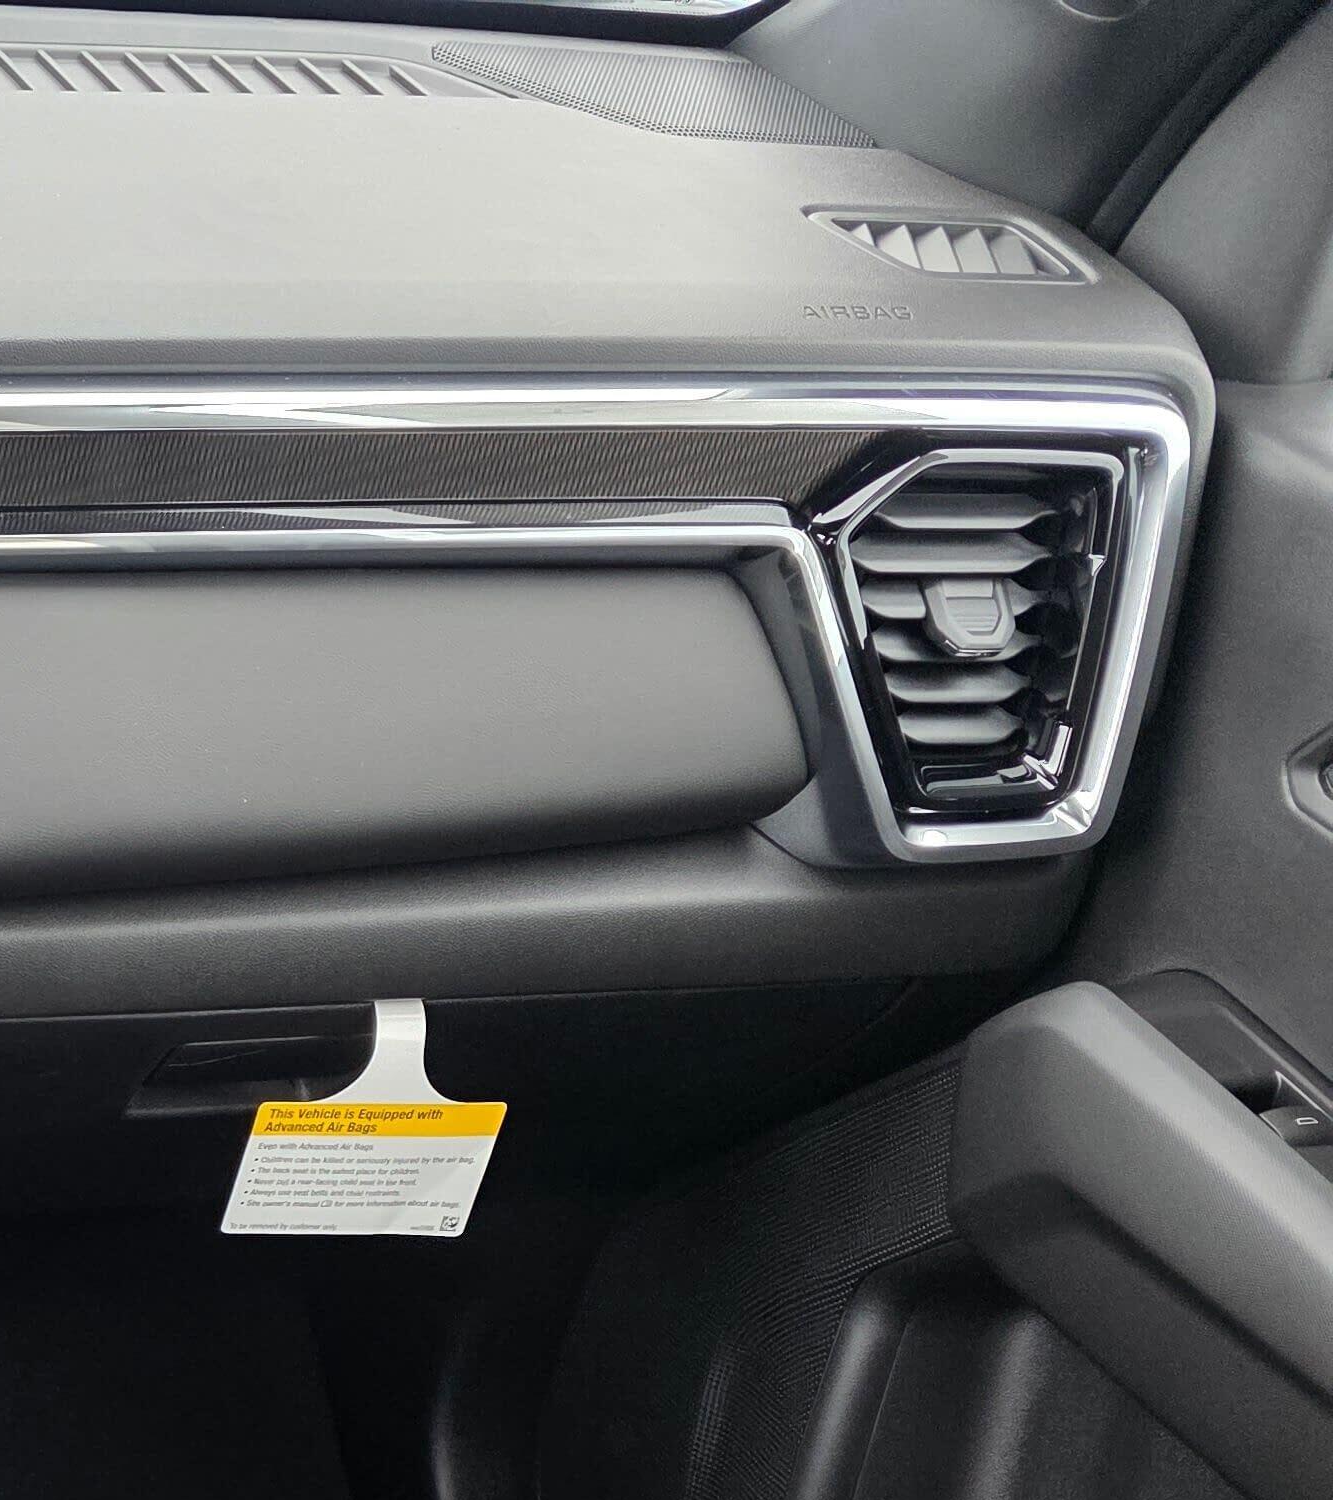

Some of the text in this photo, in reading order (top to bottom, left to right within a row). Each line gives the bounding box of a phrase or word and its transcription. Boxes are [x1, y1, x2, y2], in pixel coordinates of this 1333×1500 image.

[803, 305, 914, 321] AIRBAG
[269, 1108, 443, 1121] This Vehicle is Equipped with
[264, 1122, 377, 1134] Advanced Air Bags
